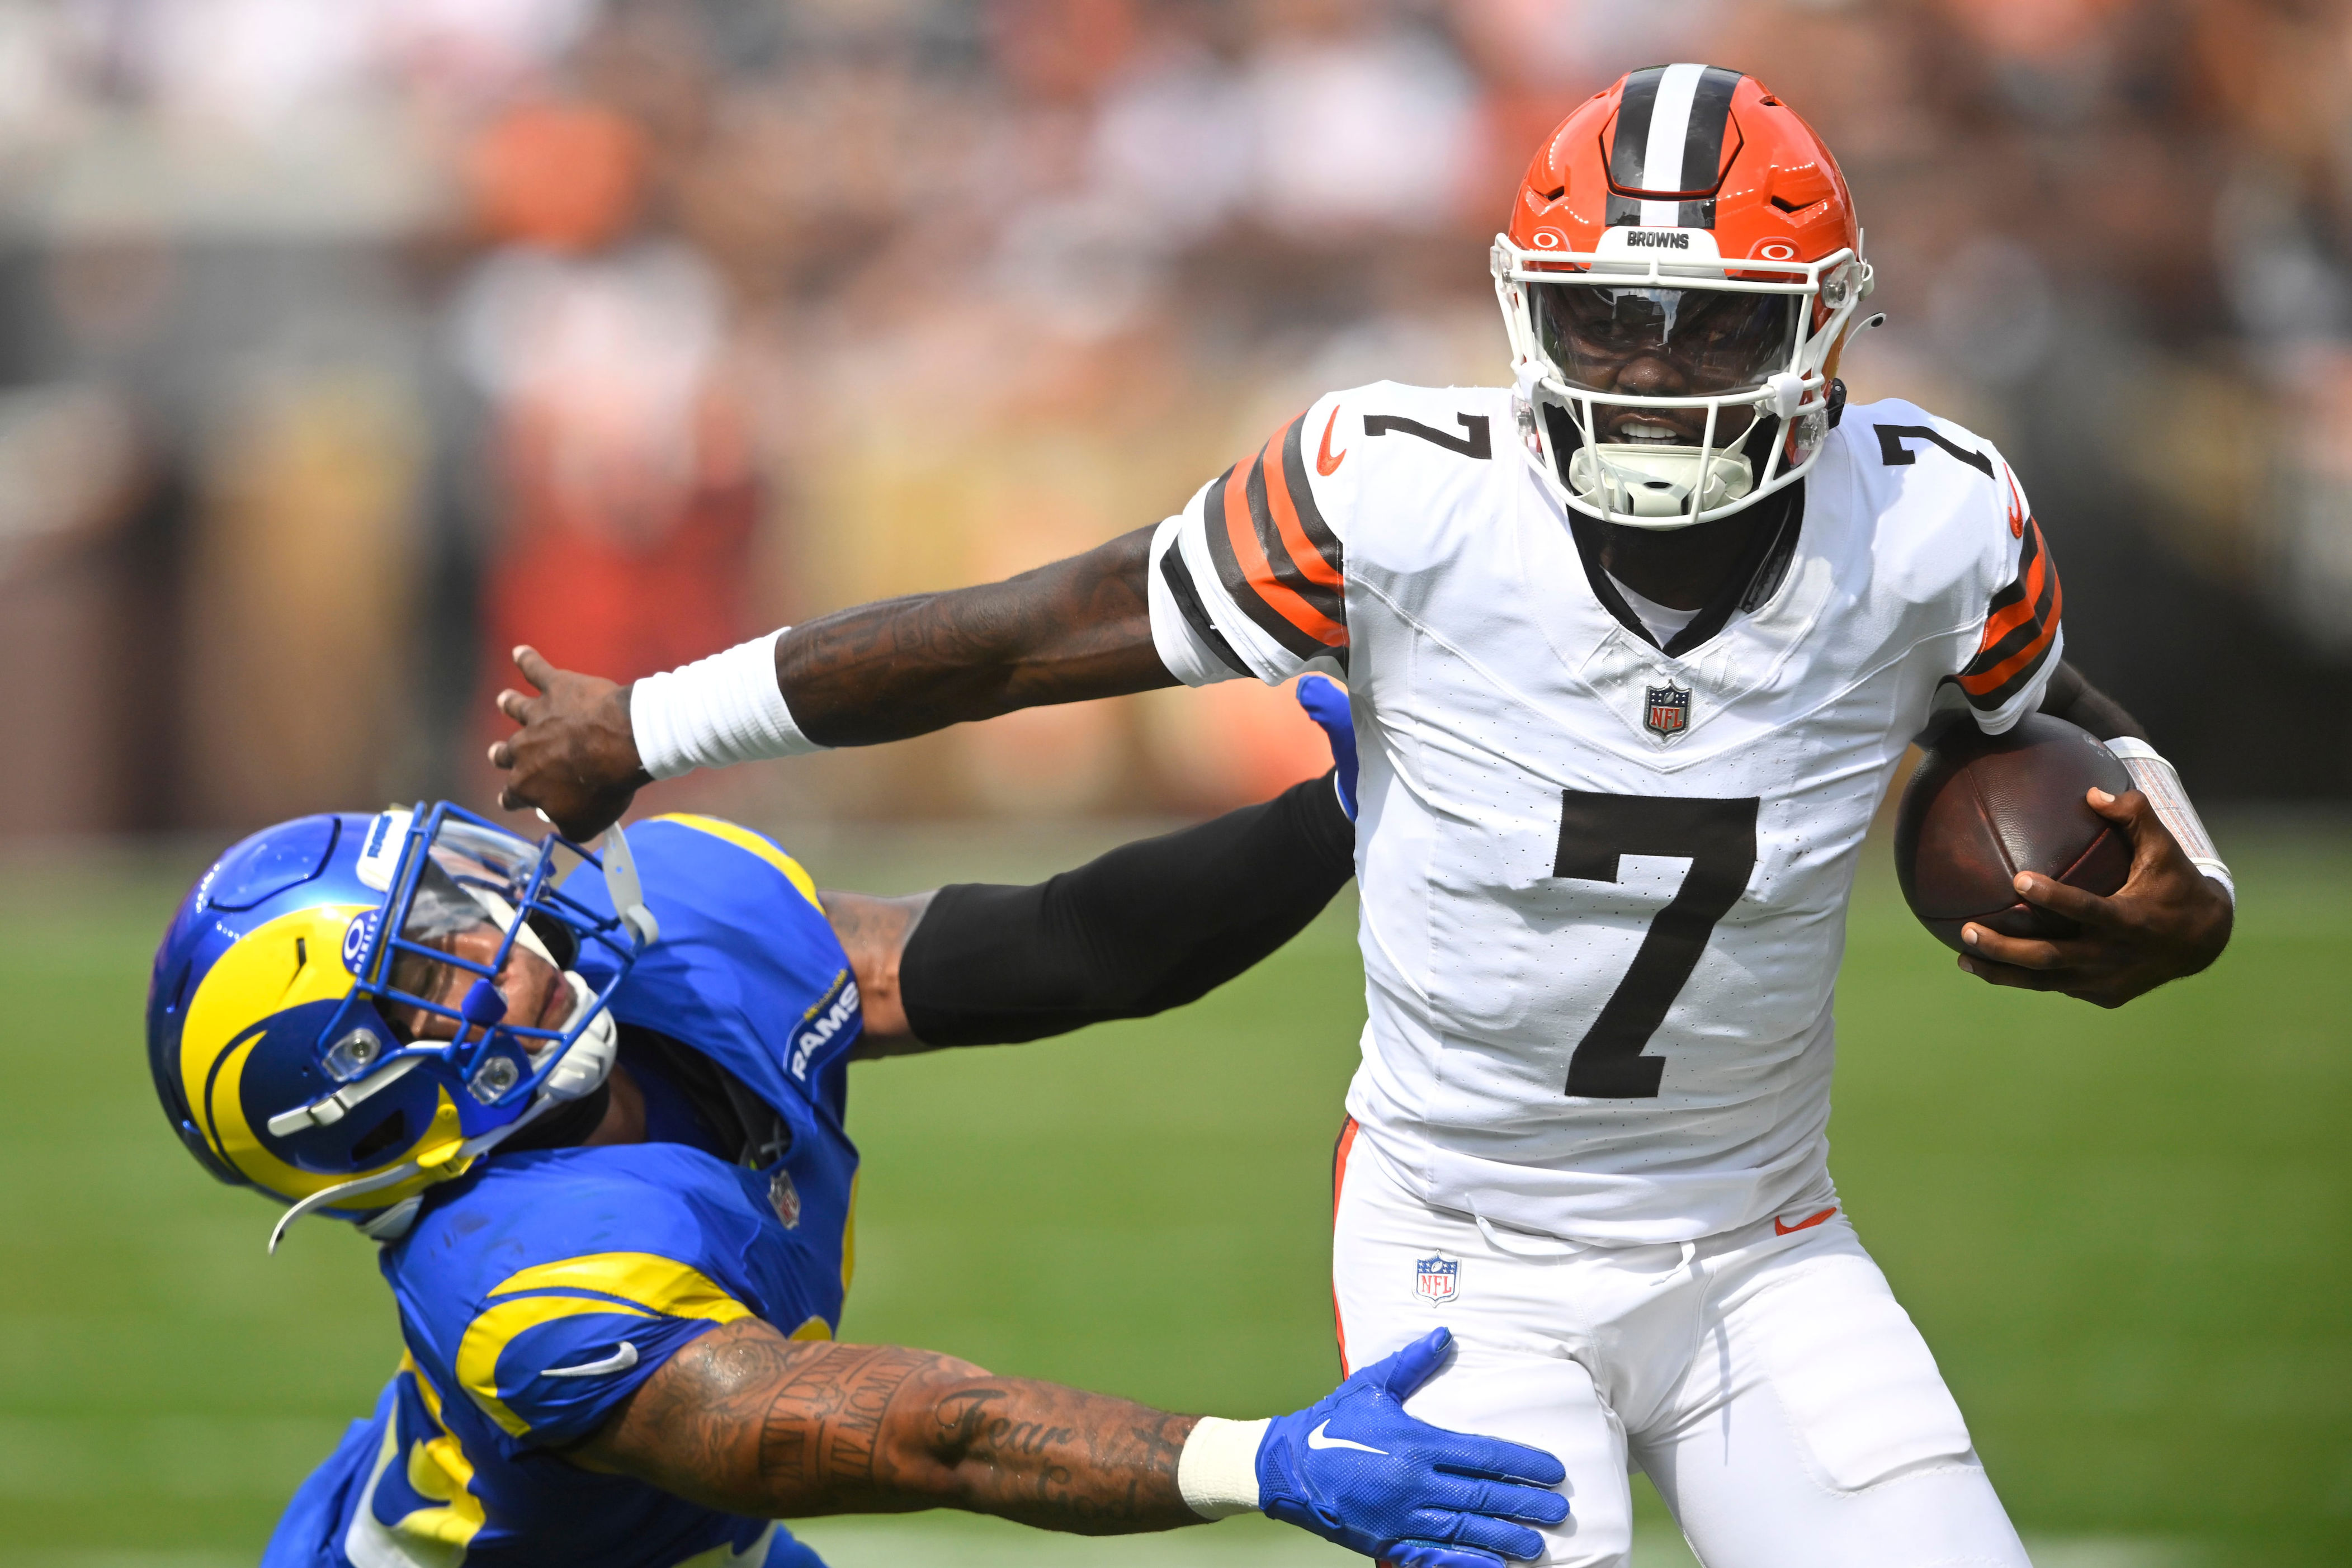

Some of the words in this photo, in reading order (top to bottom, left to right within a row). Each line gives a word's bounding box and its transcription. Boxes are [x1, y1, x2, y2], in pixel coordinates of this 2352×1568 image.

[1627, 230, 1689, 249] BROWNS
[1363, 411, 1492, 460] 7
[1873, 424, 1996, 481] 7
[1651, 707, 1683, 730] NFL
[353, 913, 377, 973] OAKLEY
[1552, 789, 1760, 1099] 7
[791, 981, 859, 1082] RAMS
[1421, 1275, 1452, 1296] NFL
[935, 1389, 1075, 1461] Fear
